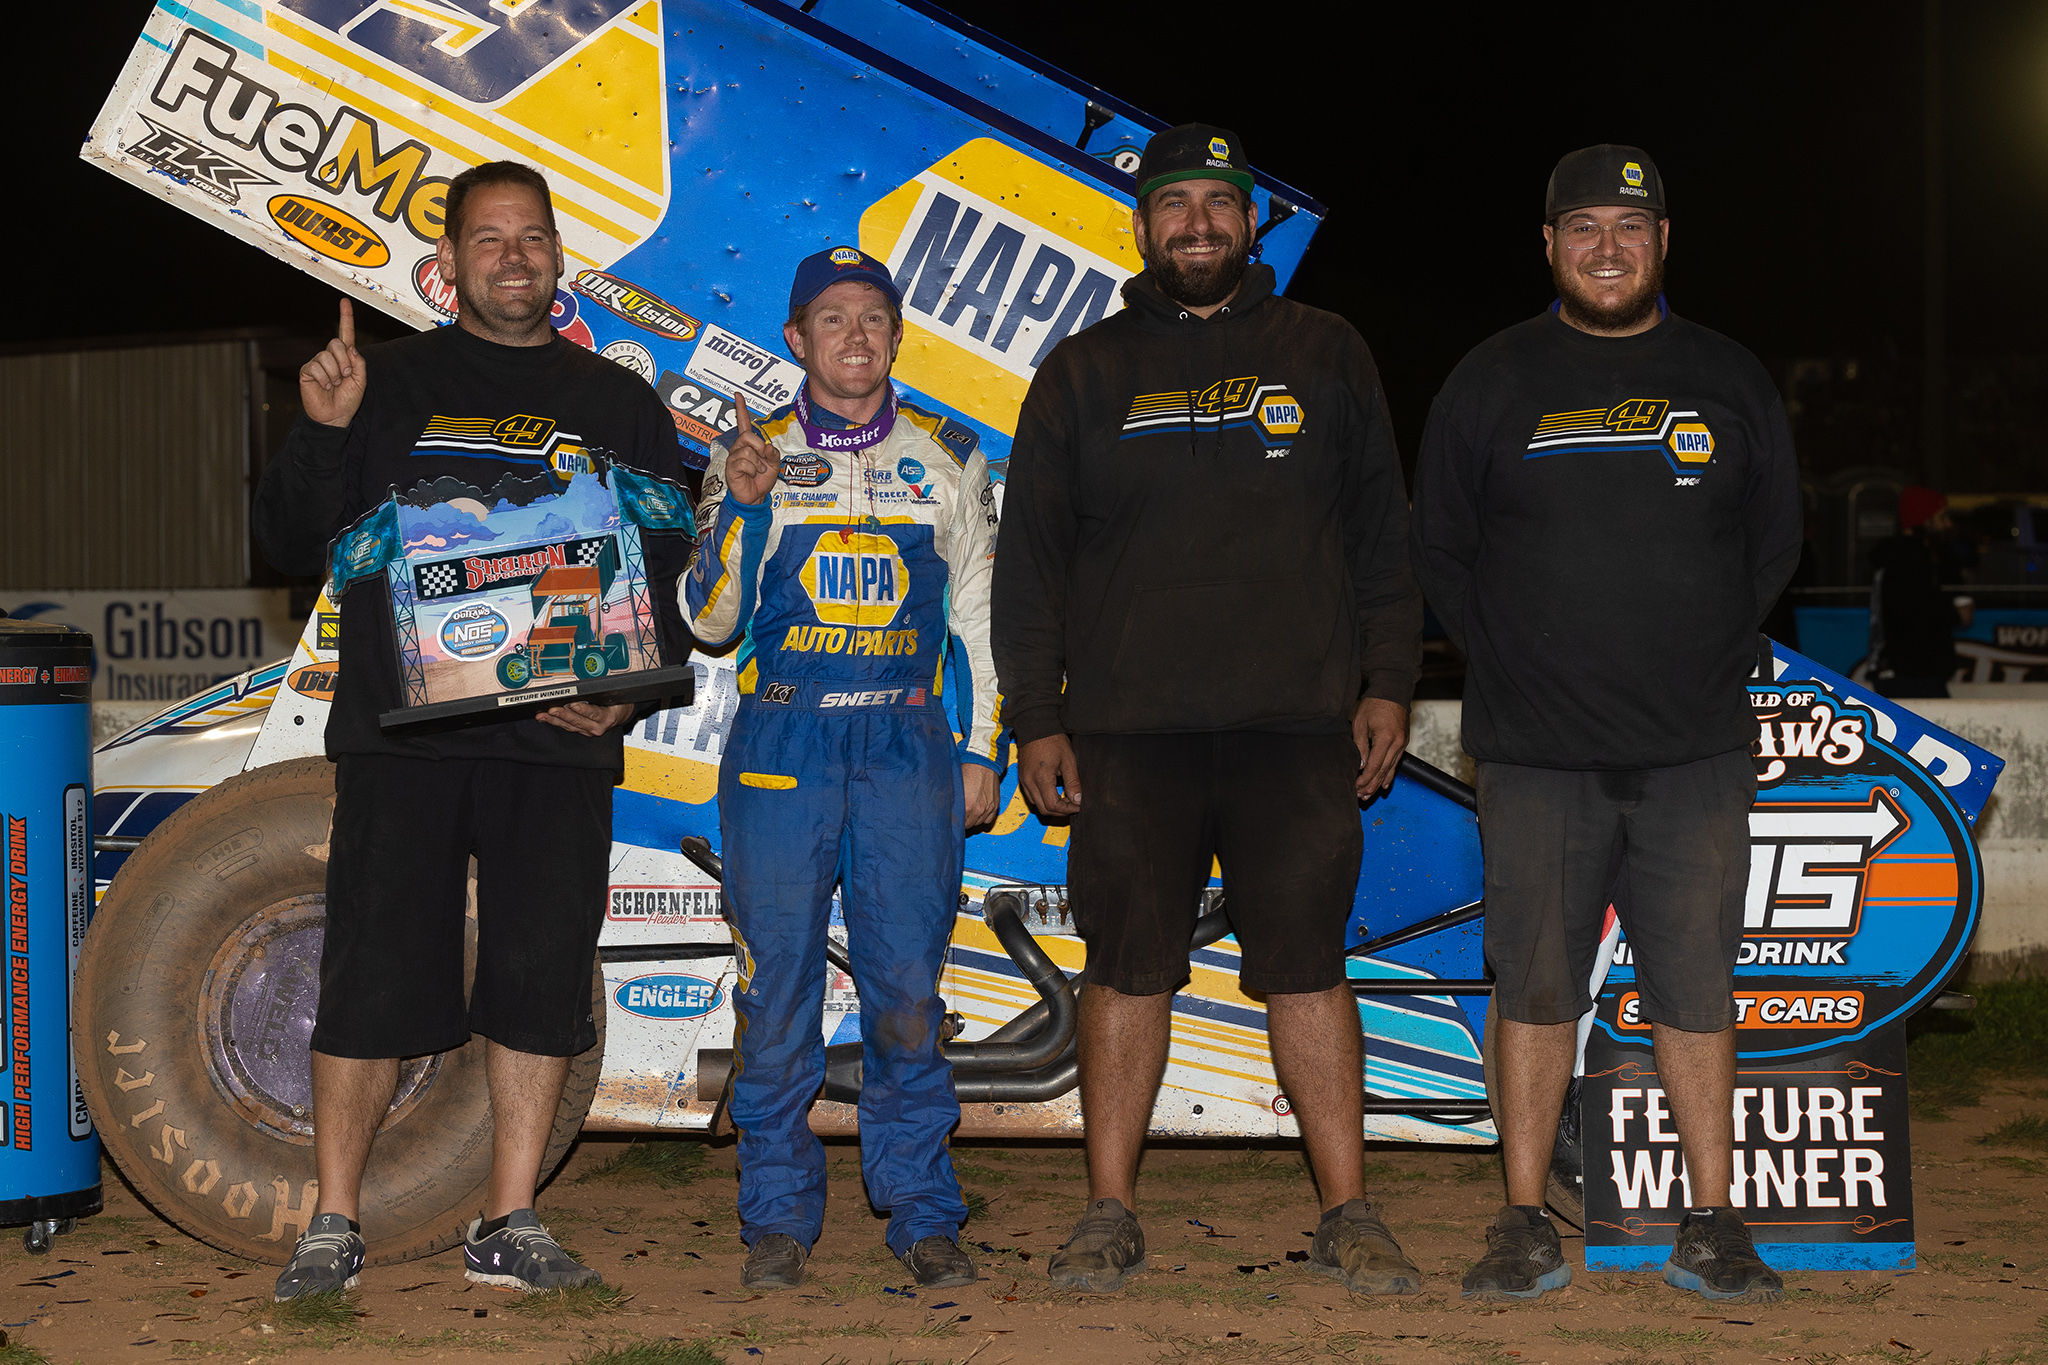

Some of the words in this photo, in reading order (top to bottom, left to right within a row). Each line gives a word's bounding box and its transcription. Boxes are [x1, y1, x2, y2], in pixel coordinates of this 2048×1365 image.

[1620, 186, 1643, 197] RACING
[274, 199, 381, 258] DURST
[834, 251, 859, 261] NAPA
[423, 296, 459, 320] COMPAN
[1197, 376, 1259, 413] 49
[1266, 405, 1299, 424] NAPA
[1605, 398, 1670, 432] 49
[492, 414, 557, 446] 49
[817, 425, 880, 448] Hoosier
[1676, 433, 1710, 452] NAPA
[557, 452, 588, 474] NAPA
[785, 463, 819, 477] NOS
[783, 492, 801, 500] TIME
[801, 492, 838, 502] CHAMPION
[819, 555, 894, 602] NAPA
[104, 602, 263, 661] Gibson
[454, 620, 496, 644] NOS
[780, 625, 847, 654] AUTO
[846, 626, 919, 656] PARTS
[505, 692, 540, 703] FEATURE
[540, 688, 571, 698] WINNER
[762, 682, 797, 705] K1
[819, 689, 903, 708] SWEET
[1786, 692, 1815, 707] OF
[76, 798, 84, 822] B12
[8, 812, 27, 876] DRINK
[70, 816, 79, 869] INOSITOL
[77, 824, 85, 873] VITAMIN
[9, 874, 28, 954] ENERGY
[71, 890, 80, 947] CAFFEINE
[77, 882, 86, 939] GUARANA
[647, 910, 688, 925] Headers
[1736, 942, 1848, 965] DRINK
[627, 984, 715, 1008] ENGLER
[1760, 997, 1859, 1022] CARS
[11, 954, 31, 1101] PERFORMANCE
[13, 1102, 32, 1151] HIGH
[1608, 1086, 1884, 1143] FETURE
